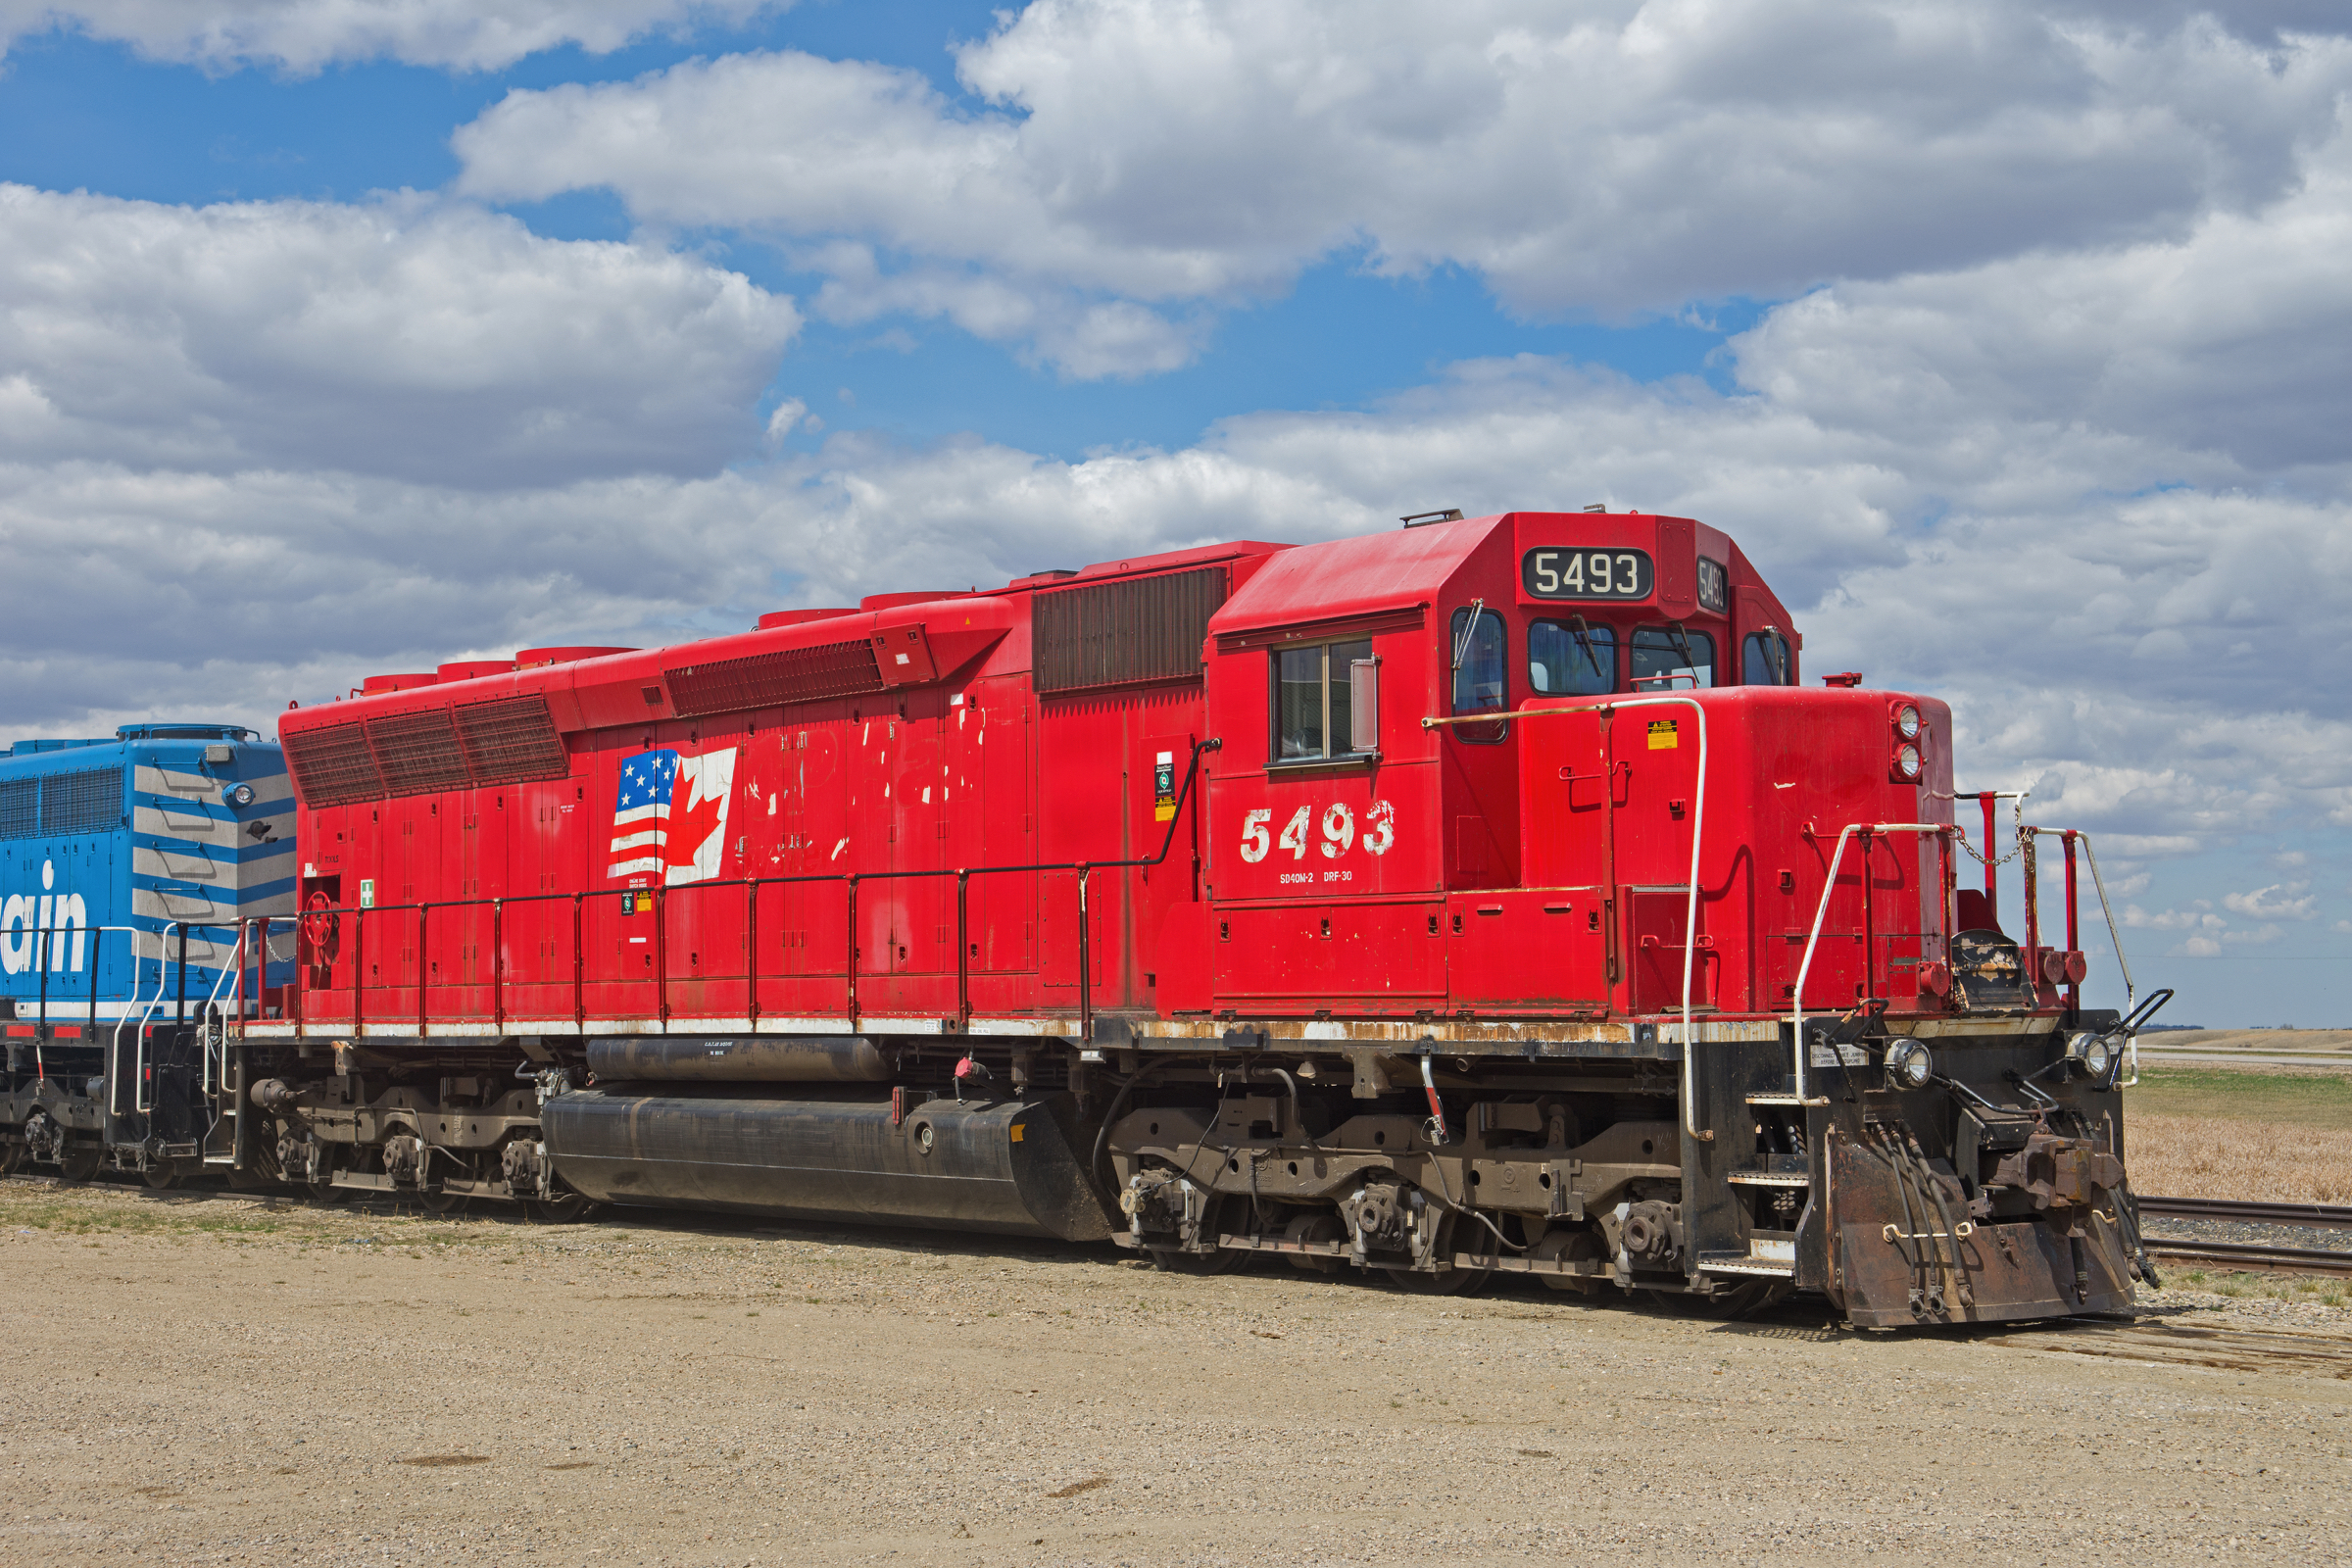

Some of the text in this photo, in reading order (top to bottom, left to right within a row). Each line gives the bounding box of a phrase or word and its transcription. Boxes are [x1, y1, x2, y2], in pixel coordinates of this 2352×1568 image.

[1536, 552, 1638, 594] 5493
[1699, 562, 1724, 608] 5493
[1240, 800, 1396, 863] 5493
[324, 855, 339, 863] TOOLS
[1323, 870, 1352, 882] DRF-30
[0, 858, 87, 975] ain
